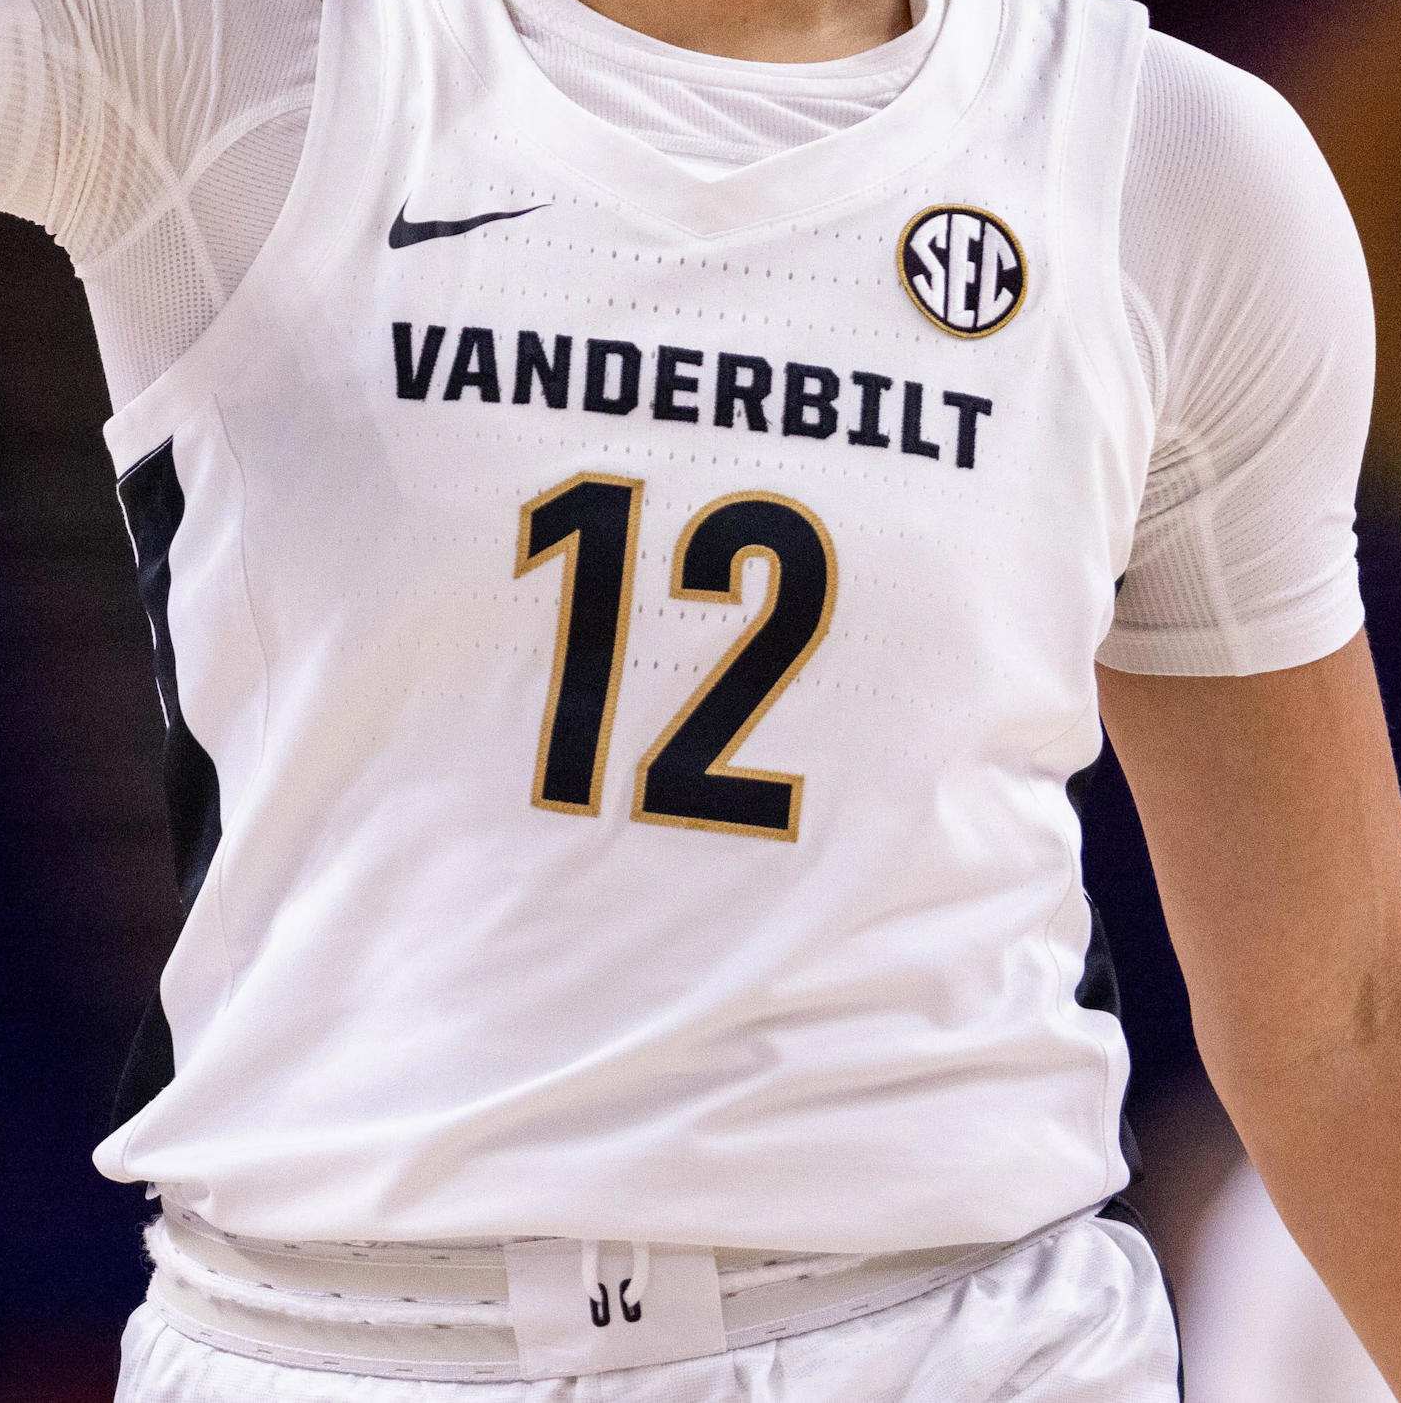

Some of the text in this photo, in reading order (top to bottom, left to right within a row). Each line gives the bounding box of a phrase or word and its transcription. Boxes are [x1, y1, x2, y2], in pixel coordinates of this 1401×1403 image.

[909, 212, 1018, 329] SEC
[391, 321, 993, 470] VANDERBILT
[513, 470, 839, 843] 12
